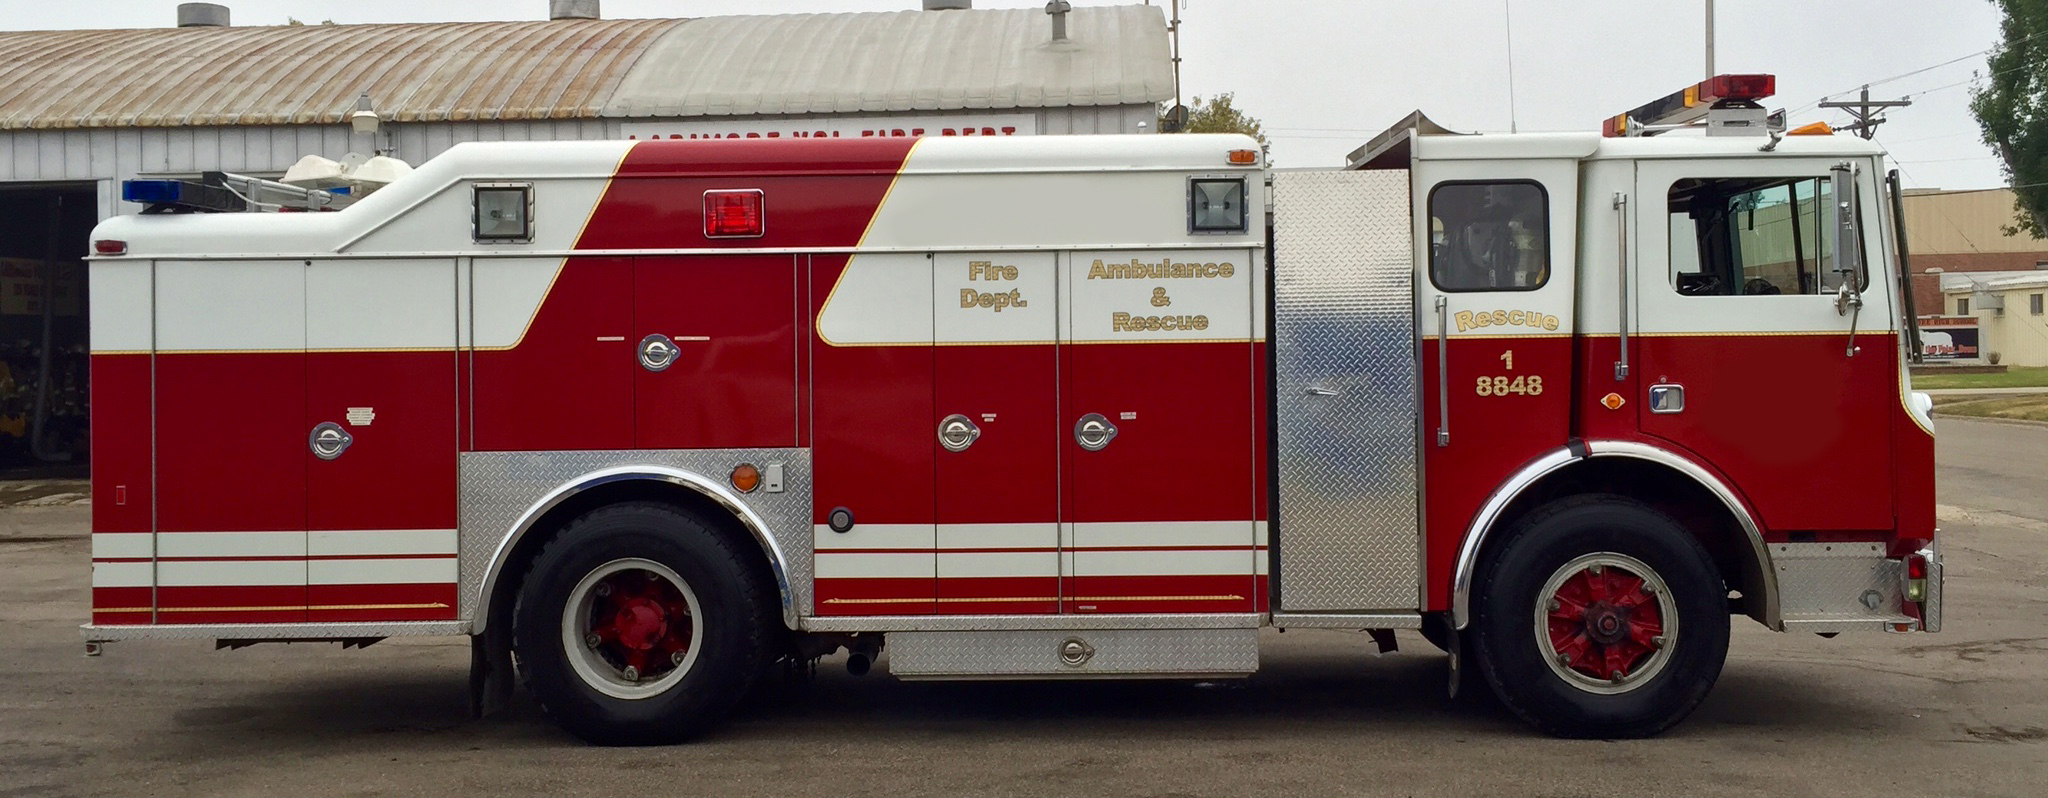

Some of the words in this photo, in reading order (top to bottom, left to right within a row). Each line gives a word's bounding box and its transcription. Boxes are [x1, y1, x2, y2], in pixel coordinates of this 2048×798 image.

[969, 261, 1019, 281] Fire
[1087, 259, 1236, 280] Ambulance
[960, 288, 1028, 312] Dept.
[1150, 286, 1172, 307] &
[1112, 312, 1210, 332] Rescue
[1454, 309, 1560, 333] Rescue
[1500, 350, 1513, 370] 1
[1475, 375, 1543, 396] 8848
